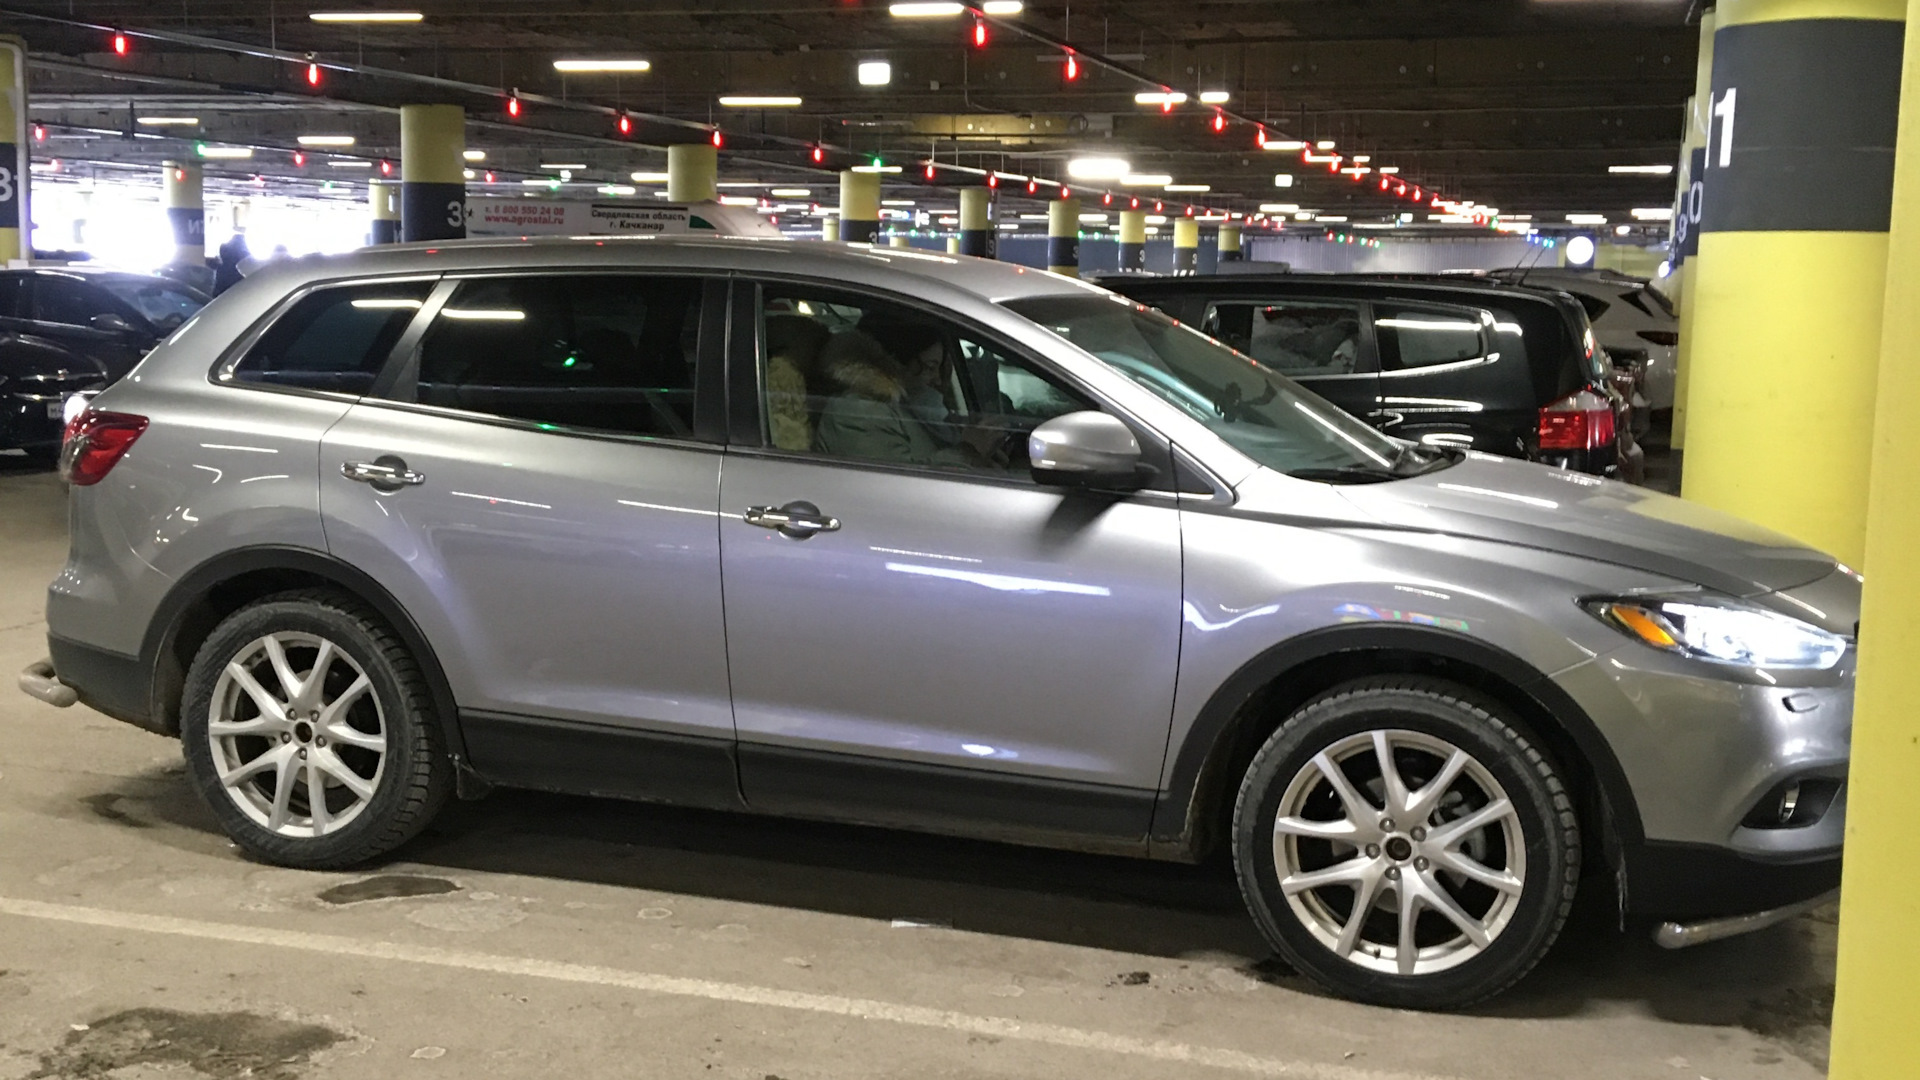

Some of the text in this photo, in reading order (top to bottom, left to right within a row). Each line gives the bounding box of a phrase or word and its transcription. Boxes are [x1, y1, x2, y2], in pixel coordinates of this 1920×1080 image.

[447, 200, 467, 228] 3
[502, 205, 519, 214] 800
[521, 206, 538, 215] 550
[540, 206, 551, 215] 24
[591, 209, 686, 221] Свердловская область
[485, 214, 564, 226] www.agrostal.ru
[619, 220, 665, 232] Качканар
